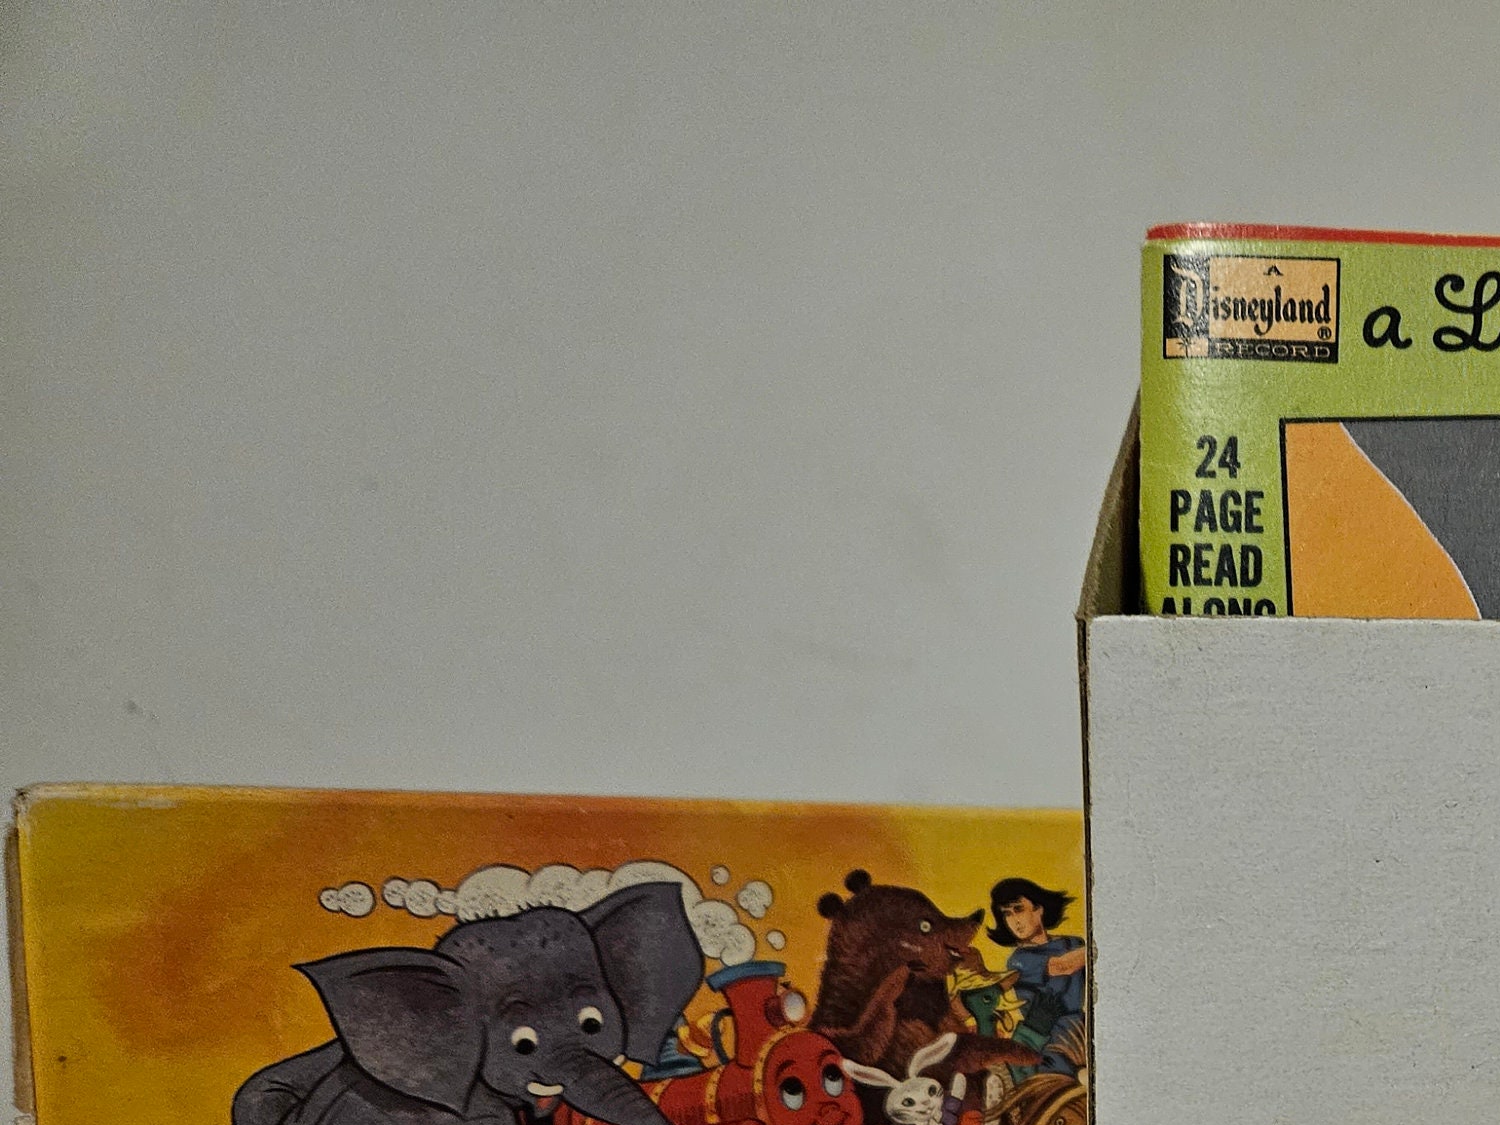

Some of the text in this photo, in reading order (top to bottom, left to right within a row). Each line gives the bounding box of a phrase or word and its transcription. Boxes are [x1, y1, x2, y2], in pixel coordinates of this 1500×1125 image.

[1263, 265, 1284, 276] A
[1170, 263, 1332, 336] Disneyland
[1363, 305, 1412, 348] a
[1216, 342, 1331, 358] RECORD
[1195, 435, 1241, 478] 24
[1169, 489, 1265, 534] PAGE
[1168, 543, 1263, 588] READ
